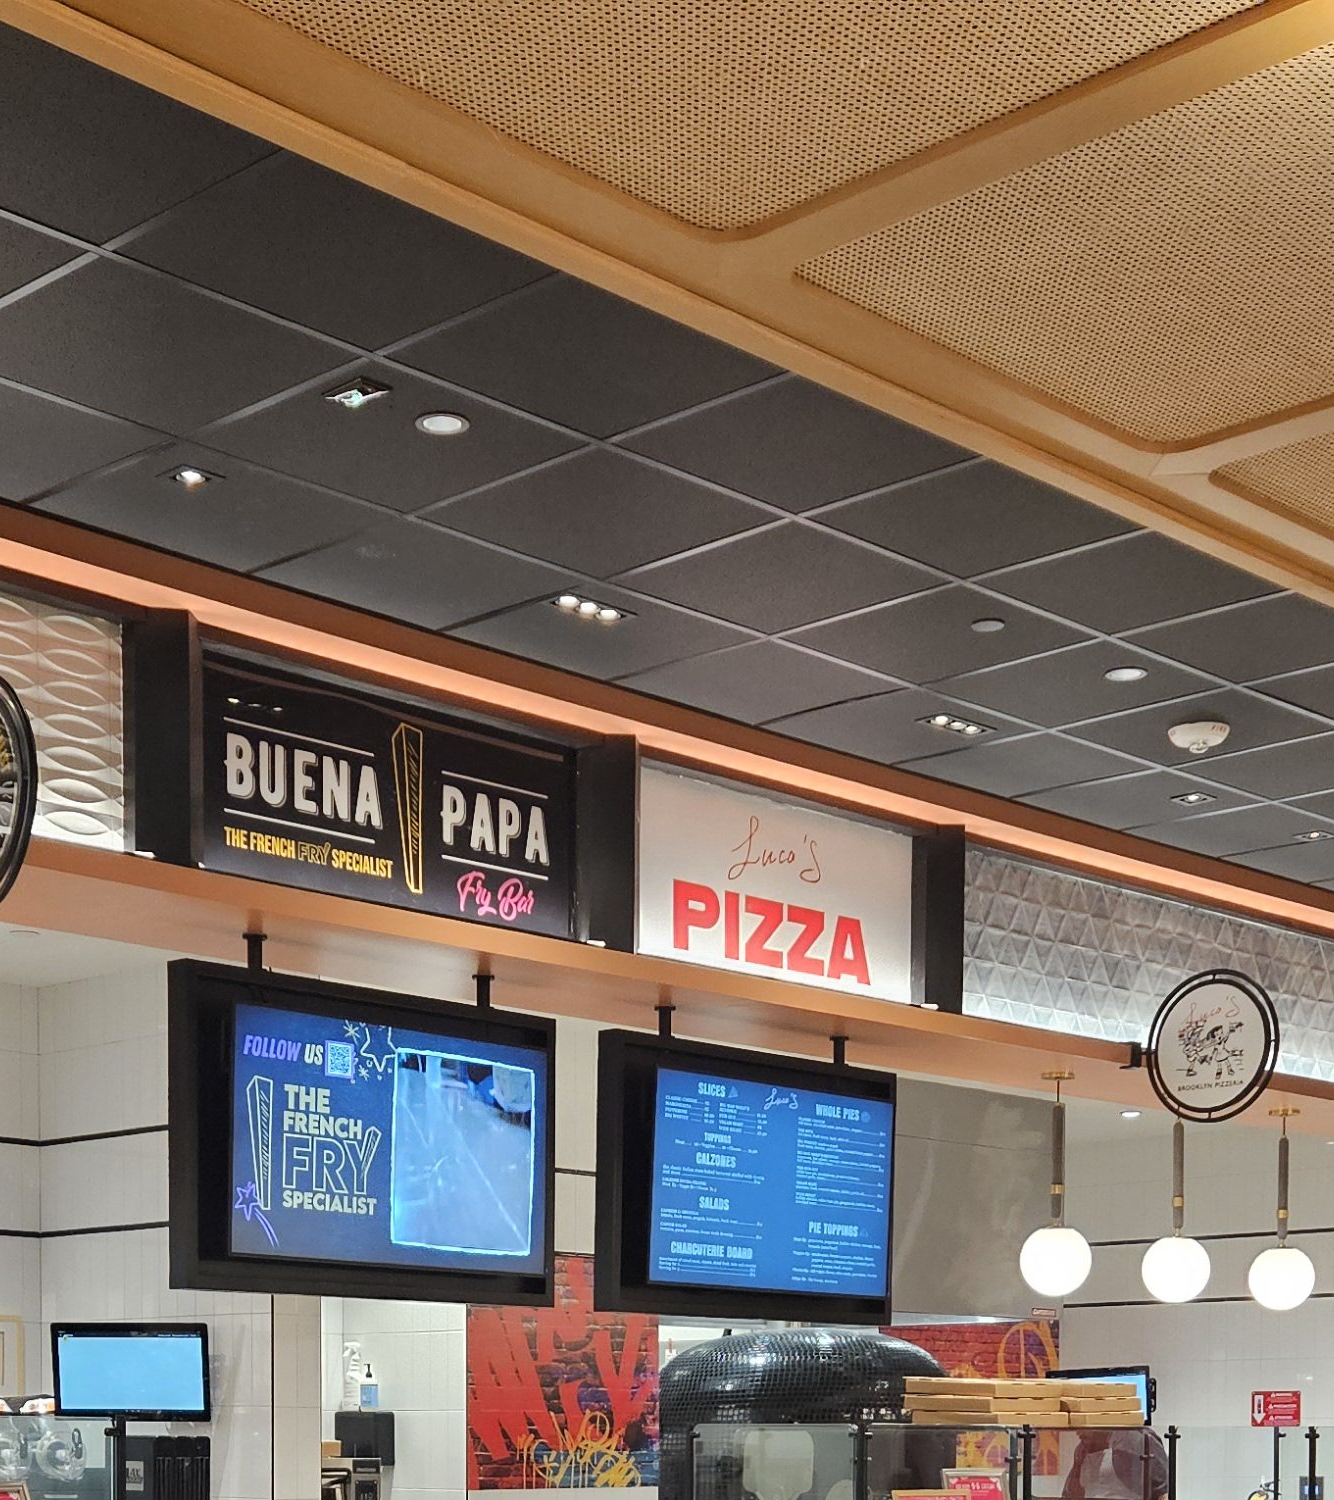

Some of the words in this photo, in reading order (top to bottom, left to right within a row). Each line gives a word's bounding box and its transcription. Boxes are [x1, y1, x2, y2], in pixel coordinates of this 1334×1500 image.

[224, 732, 383, 830] BUENA
[440, 784, 551, 867] PAPA
[224, 826, 248, 850] THE
[249, 831, 296, 860] FRENCH
[298, 842, 332, 866] FRY
[331, 848, 394, 879] SPECIALIST
[456, 870, 496, 918] Fry
[497, 877, 535, 921] Bar
[673, 878, 871, 986] PIZZA
[243, 1034, 302, 1062] FOLLOW
[304, 1044, 323, 1066] US
[698, 1082, 726, 1098] SLICES
[1177, 1083, 1213, 1092] BROOKLYN
[1214, 1079, 1244, 1088] PIZZERIA
[283, 1083, 331, 1115] THE
[282, 1111, 363, 1140] FRENCH
[815, 1103, 842, 1119] WHOLE
[842, 1107, 860, 1122] PIES
[704, 1132, 732, 1144] TOPPINGS
[282, 1125, 382, 1195] FRY
[696, 1151, 737, 1168] CALZONES
[282, 1190, 377, 1216] SPECIALIST
[699, 1196, 730, 1211] SALADS
[808, 1221, 821, 1234] PIE
[823, 1223, 859, 1238] TOPPINGS
[670, 1241, 725, 1258] CHARCUTERIE
[726, 1245, 753, 1260] BOARD
